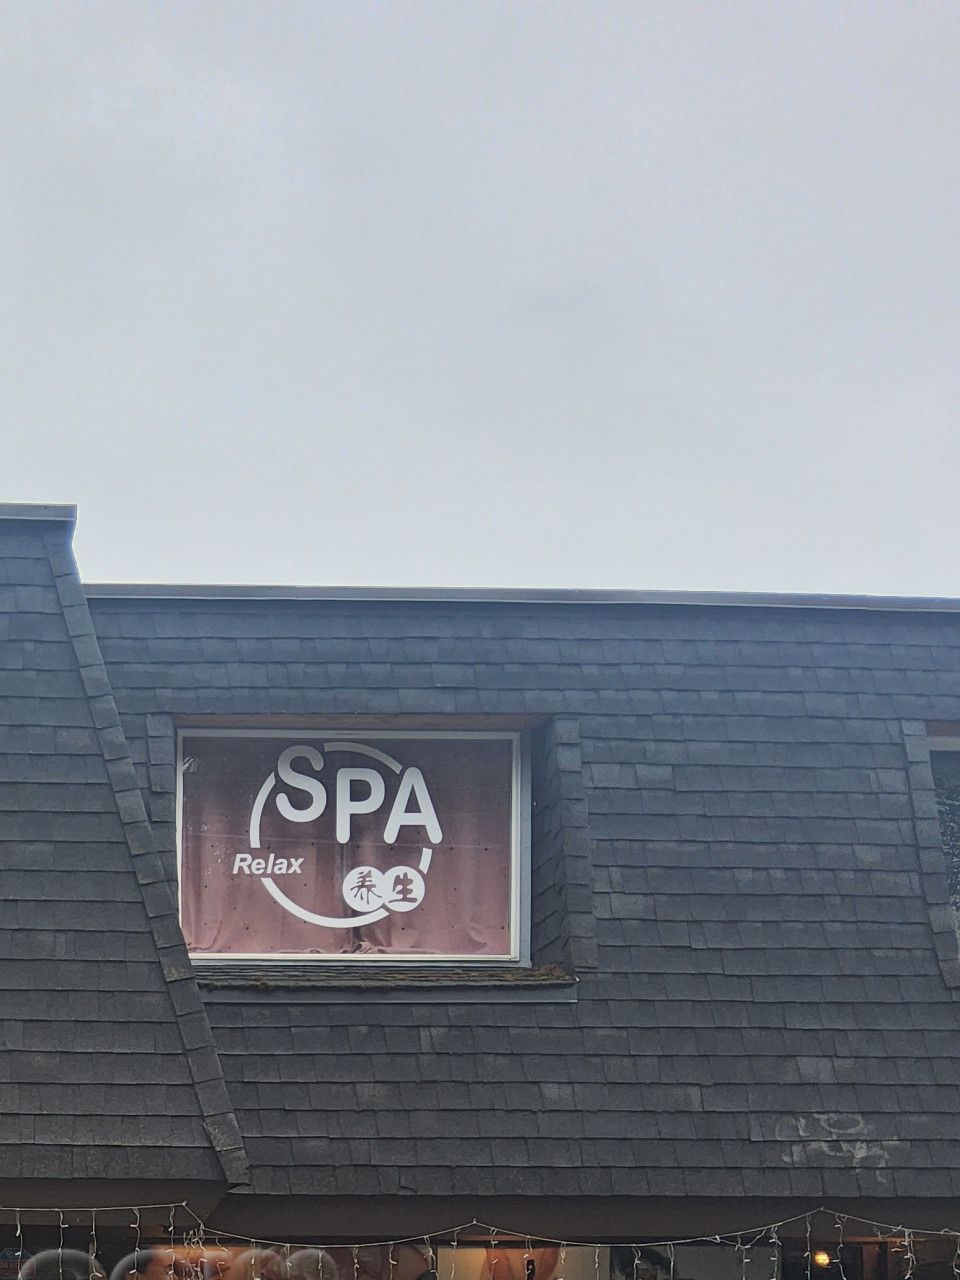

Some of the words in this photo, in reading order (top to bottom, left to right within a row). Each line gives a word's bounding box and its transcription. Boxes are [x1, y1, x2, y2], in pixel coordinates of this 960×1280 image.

[275, 744, 443, 845] SPA
[232, 853, 304, 875] Relax
[350, 870, 418, 905] 养生
